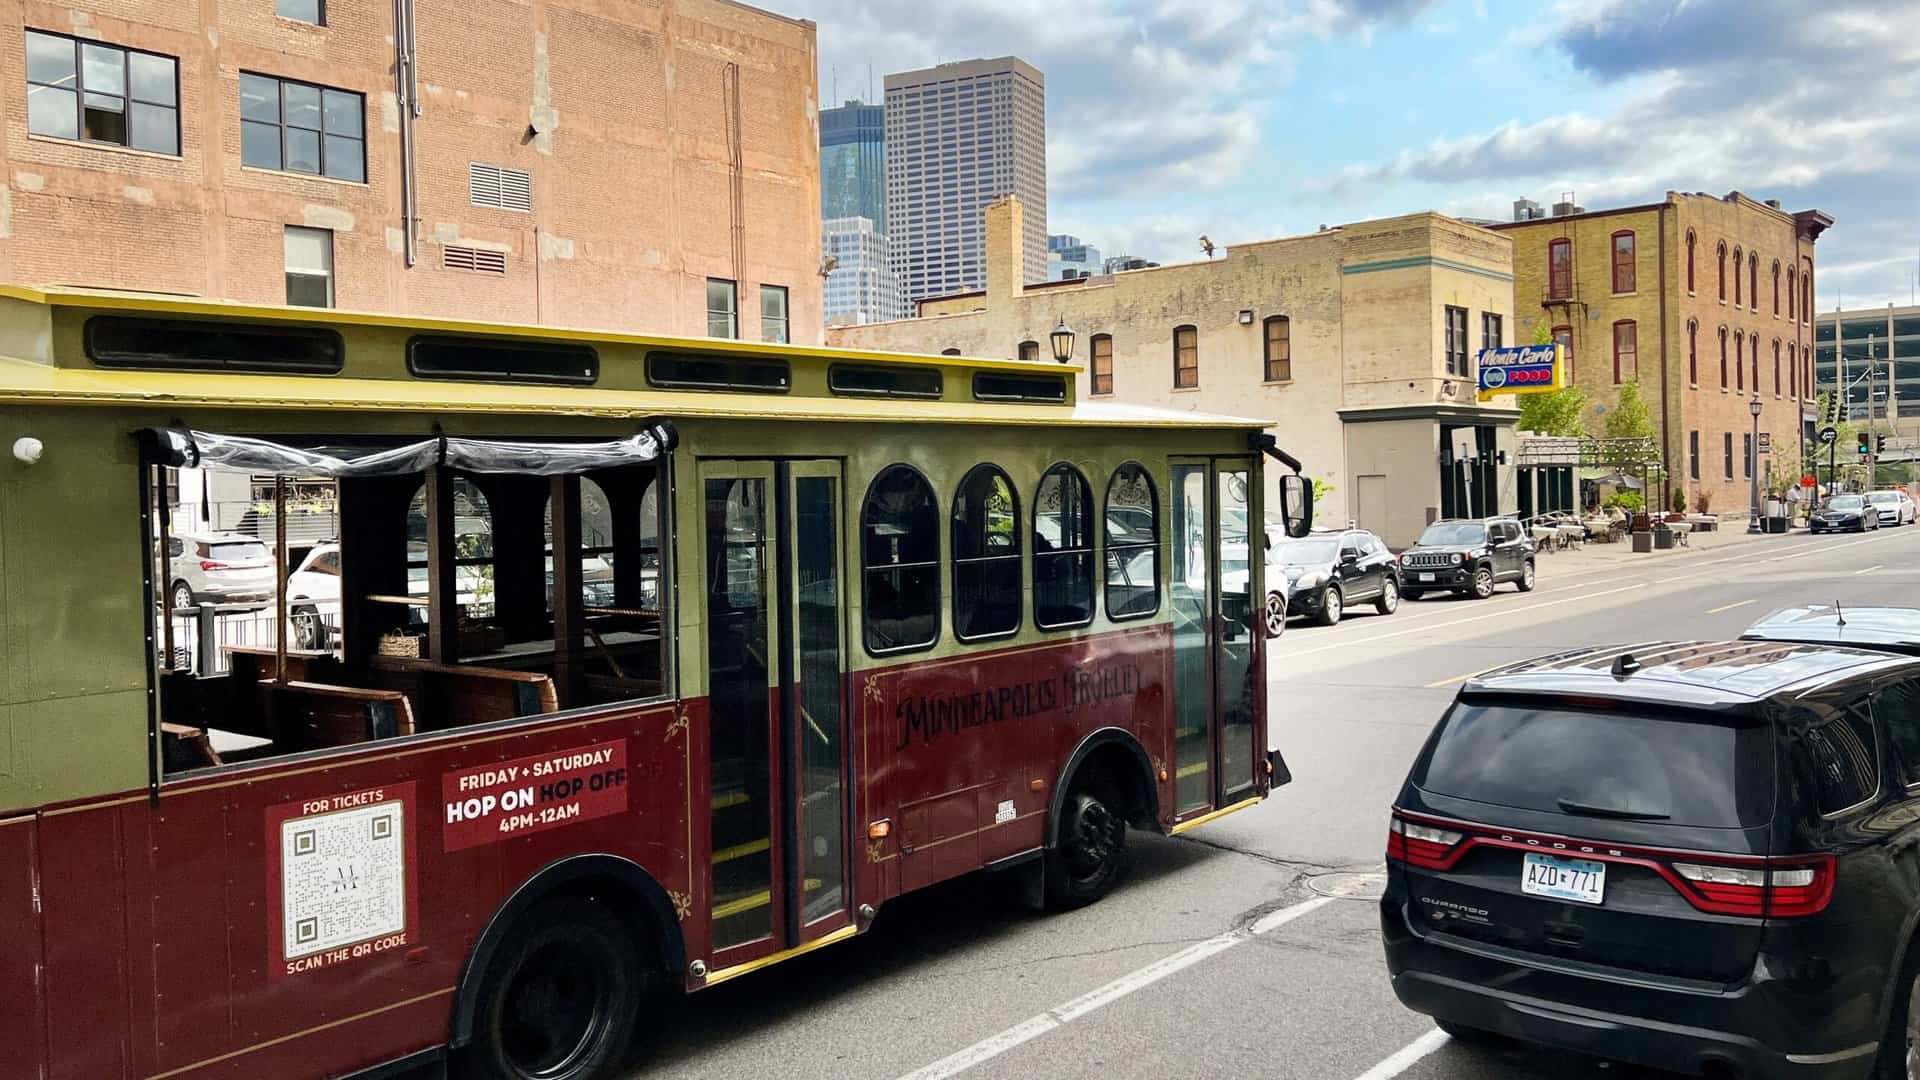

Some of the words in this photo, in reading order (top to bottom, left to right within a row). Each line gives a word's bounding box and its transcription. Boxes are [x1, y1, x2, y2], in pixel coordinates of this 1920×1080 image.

[1481, 349, 1518, 366] Monte
[1518, 347, 1554, 364] Carlo
[1509, 369, 1551, 383] FOOD
[459, 763, 520, 791] FRIDAY
[533, 748, 613, 777] SATURDAY
[303, 799, 329, 815] FOR
[332, 789, 384, 809] TICKETS
[447, 796, 496, 823] HOP
[501, 786, 534, 809] ON
[540, 777, 583, 802] HOP
[589, 767, 627, 790] OFF
[499, 802, 580, 833] 4PM-12AM
[1501, 834, 1622, 857] DODGE
[1571, 870, 1598, 893] 771
[1421, 897, 1489, 915] DURANGO
[286, 956, 323, 975] SCAN
[326, 949, 350, 965] THE
[352, 943, 371, 958] QR
[374, 933, 407, 951] CODE
